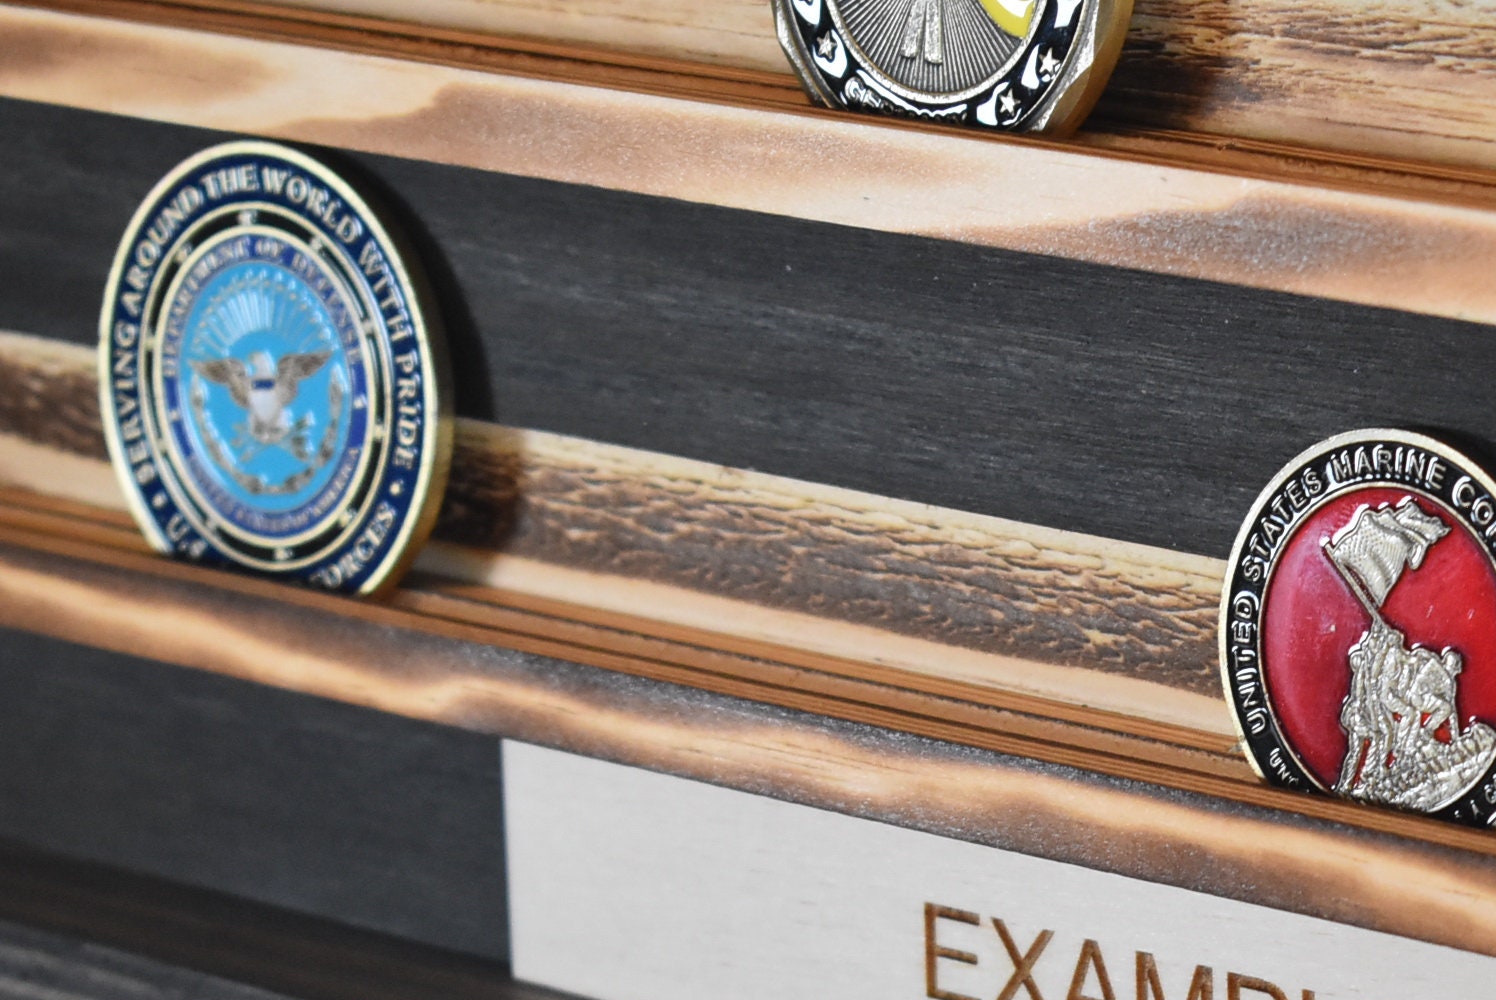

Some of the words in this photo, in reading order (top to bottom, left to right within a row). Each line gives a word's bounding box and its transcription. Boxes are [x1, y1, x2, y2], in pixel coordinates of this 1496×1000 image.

[199, 164, 257, 200] THE
[261, 165, 364, 244] WORLD
[120, 187, 205, 317] AROUND
[357, 240, 411, 343] WITH
[113, 323, 156, 483] SERVING
[393, 346, 420, 470] PRIDE
[1329, 445, 1448, 490] MARINE
[1243, 469, 1323, 582] STATES
[1232, 591, 1267, 736] UNITED
